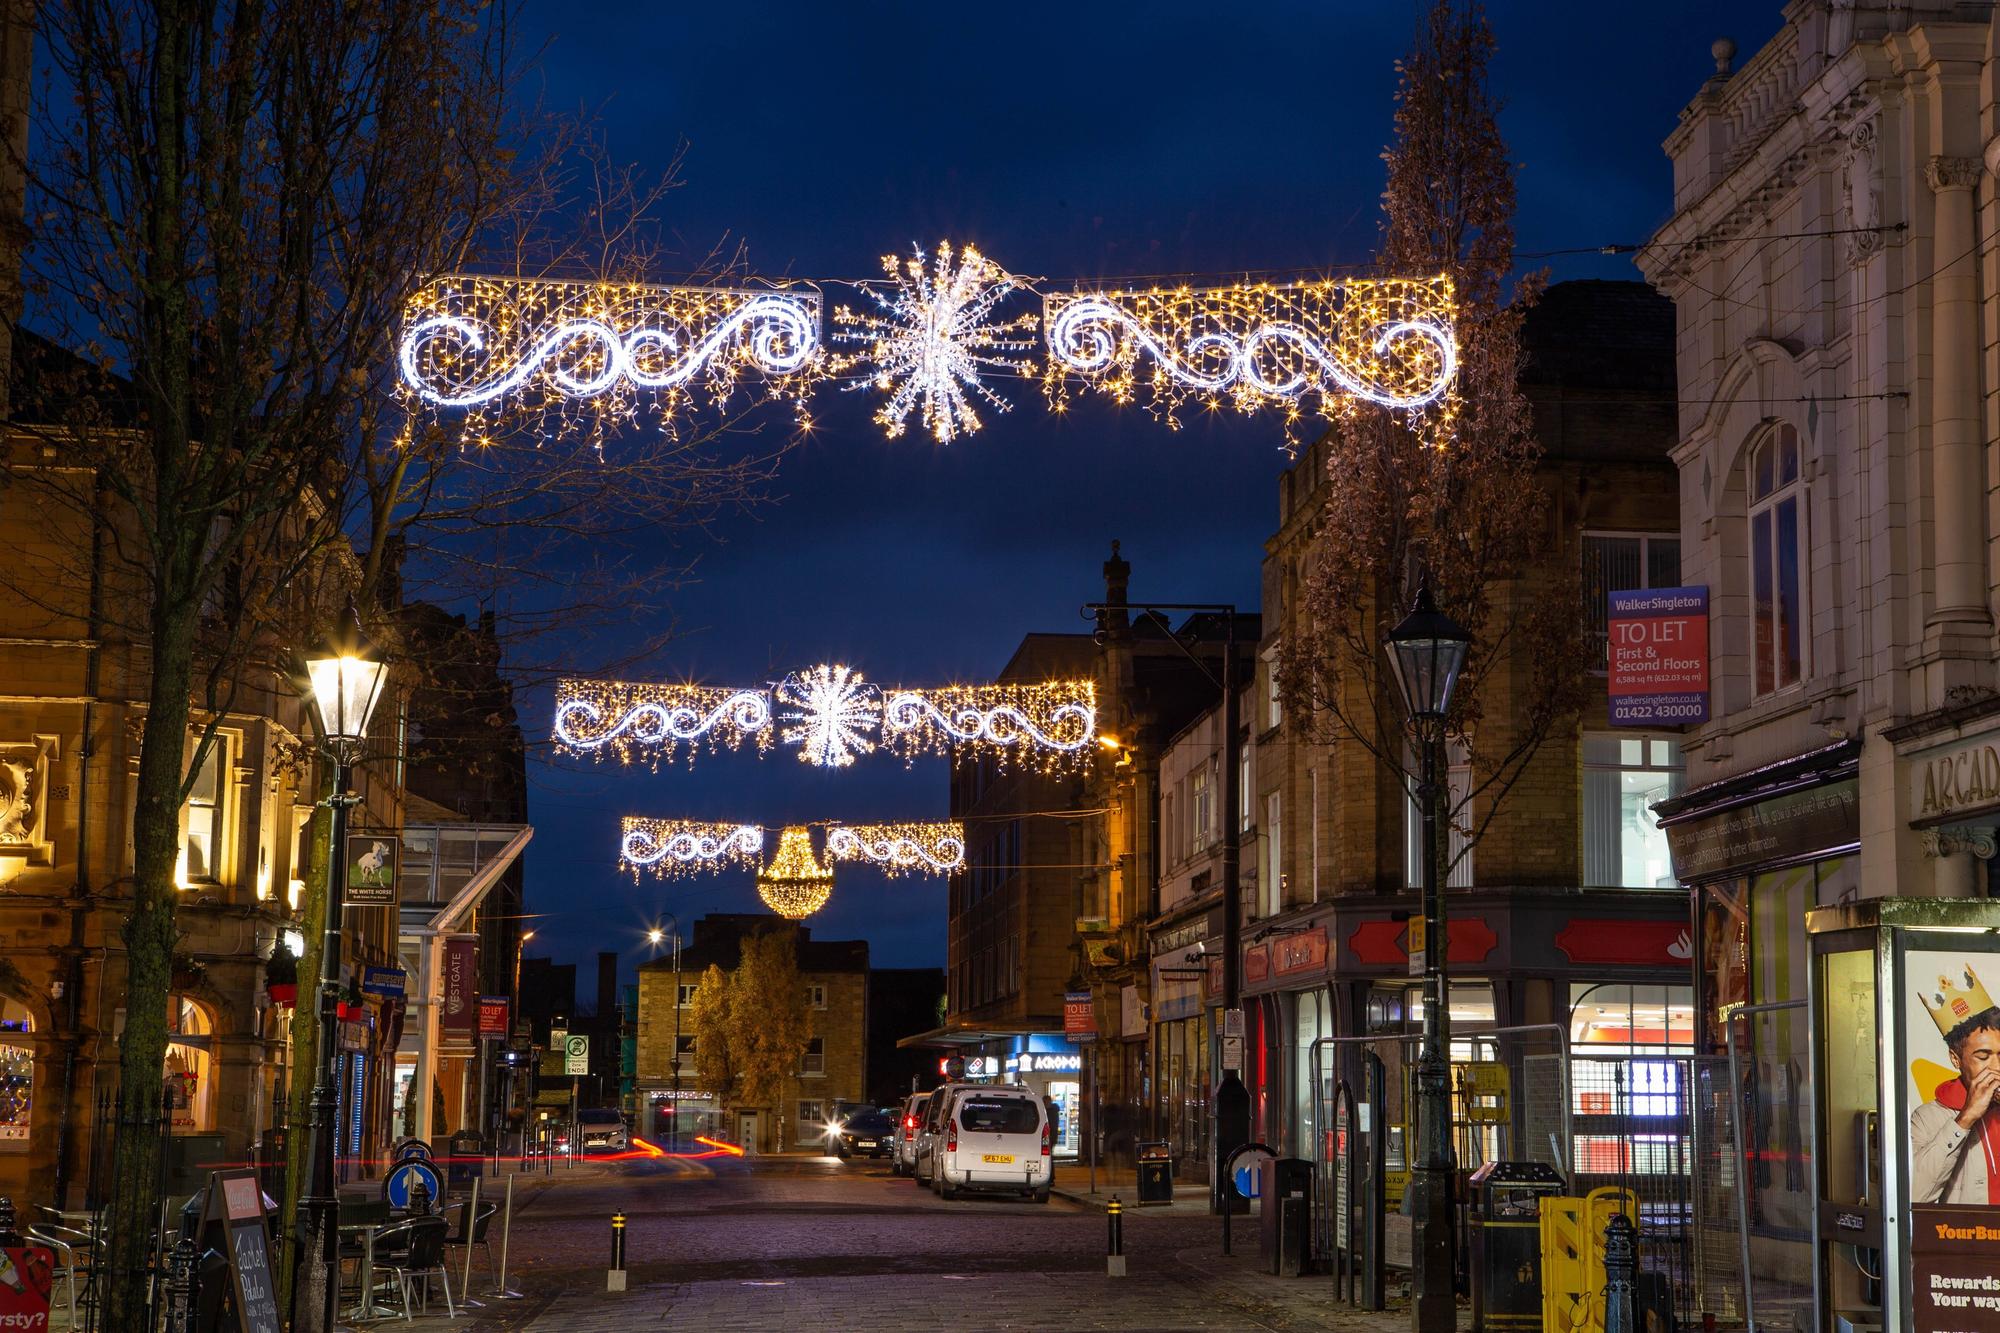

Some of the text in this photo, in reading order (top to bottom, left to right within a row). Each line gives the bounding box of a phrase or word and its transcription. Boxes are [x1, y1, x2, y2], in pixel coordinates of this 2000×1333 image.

[1616, 621, 1687, 644] TO LET
[1616, 646, 1656, 659] First &
[1616, 658, 1700, 672] Second Floors
[1616, 693, 1702, 706] walkersingleton.co.uk
[1616, 704, 1702, 719] 01422 430000
[448, 952, 462, 1015] WESTGATE
[481, 1006, 502, 1015] TO LET
[1066, 1004, 1092, 1014] TO LET
[1931, 1275, 2000, 1291] Rewards
[1931, 1292, 2000, 1312] Your way
